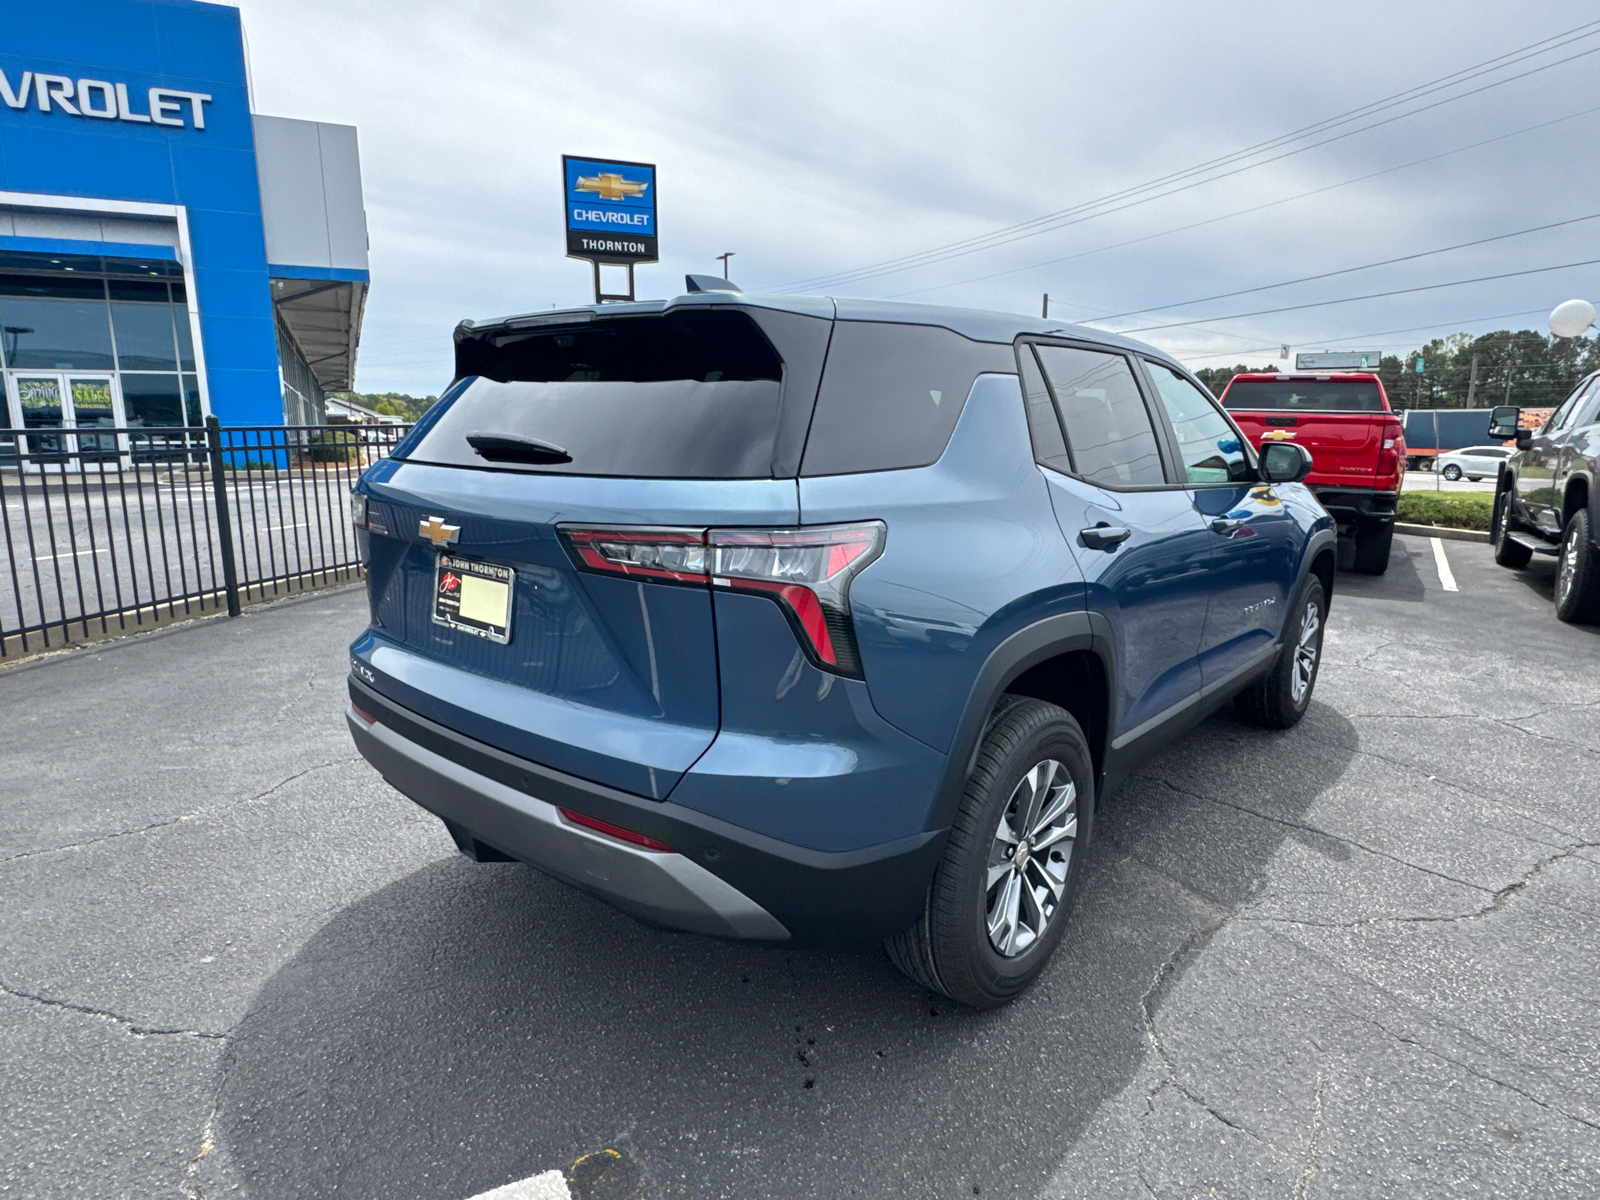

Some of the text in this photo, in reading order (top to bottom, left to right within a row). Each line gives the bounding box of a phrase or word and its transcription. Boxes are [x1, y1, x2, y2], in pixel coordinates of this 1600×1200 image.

[573, 208, 650, 226] CHEVROLET
[581, 238, 646, 253] THORNTON
[74, 387, 111, 404] SALES
[452, 558, 470, 571] JOHN
